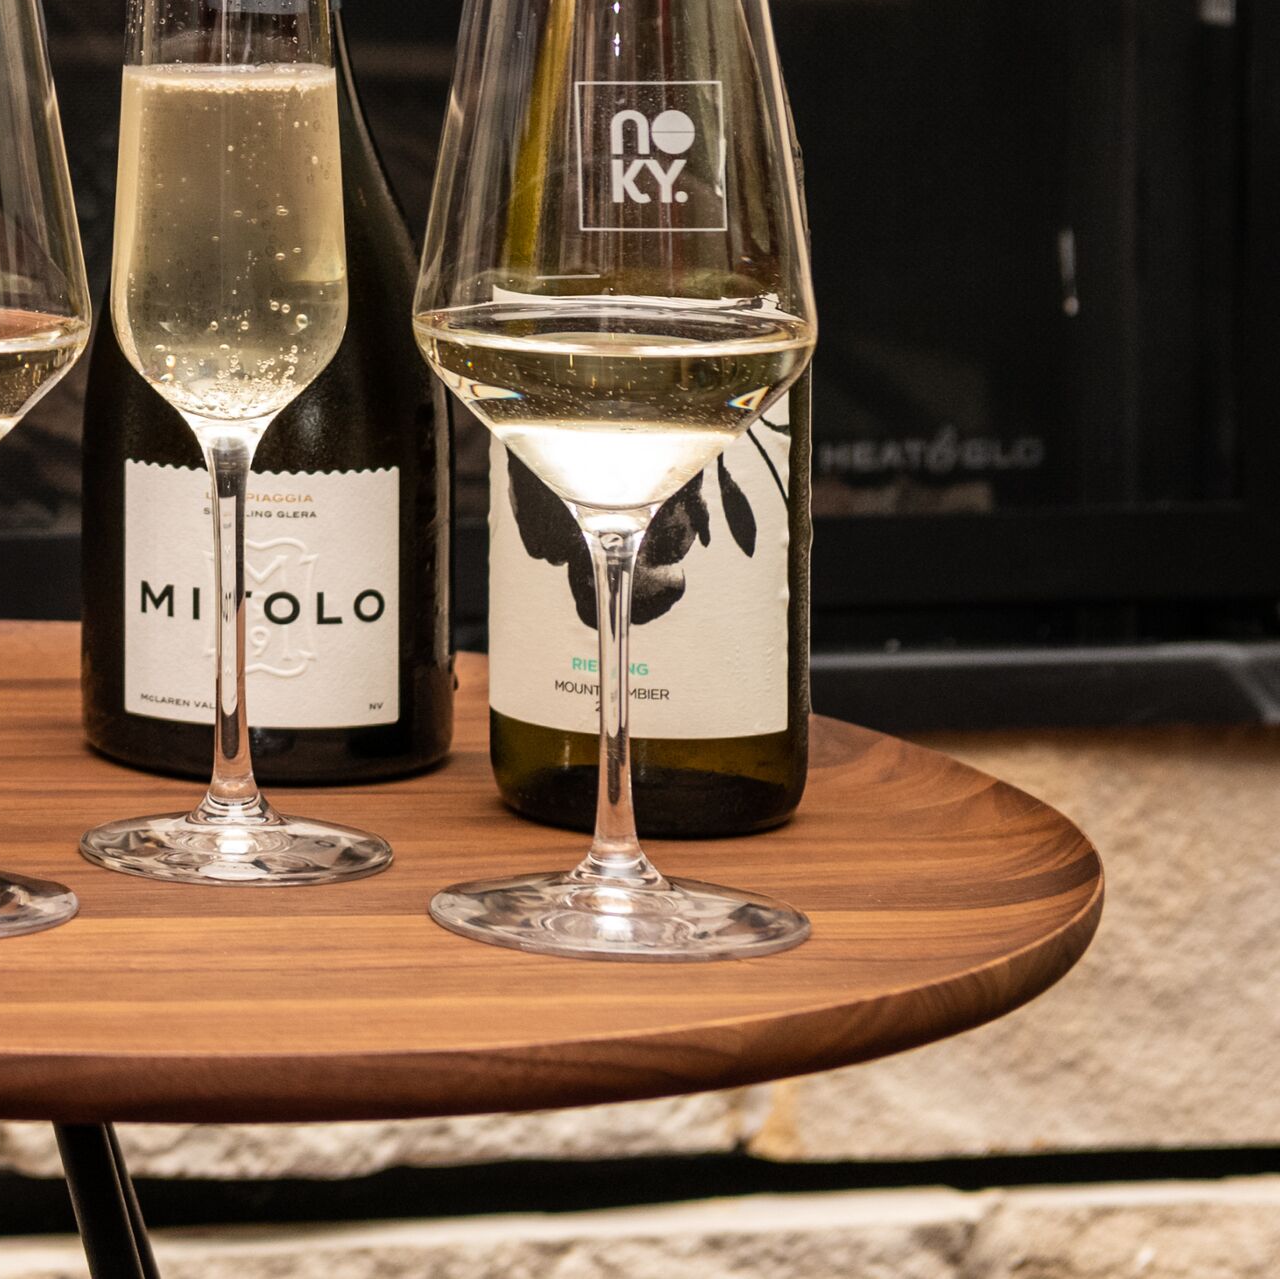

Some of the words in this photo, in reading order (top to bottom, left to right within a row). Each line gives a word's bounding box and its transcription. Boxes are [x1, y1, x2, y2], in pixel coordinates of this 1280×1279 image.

[245, 491, 315, 503] PIAGGIA
[276, 510, 317, 519] GLERA
[140, 580, 385, 625] MIOLO
[572, 657, 649, 676] RIENG
[554, 680, 600, 696] MOUNT
[627, 687, 670, 701] MBIER
[193, 701, 217, 710] VAL
[369, 702, 384, 710] NV
